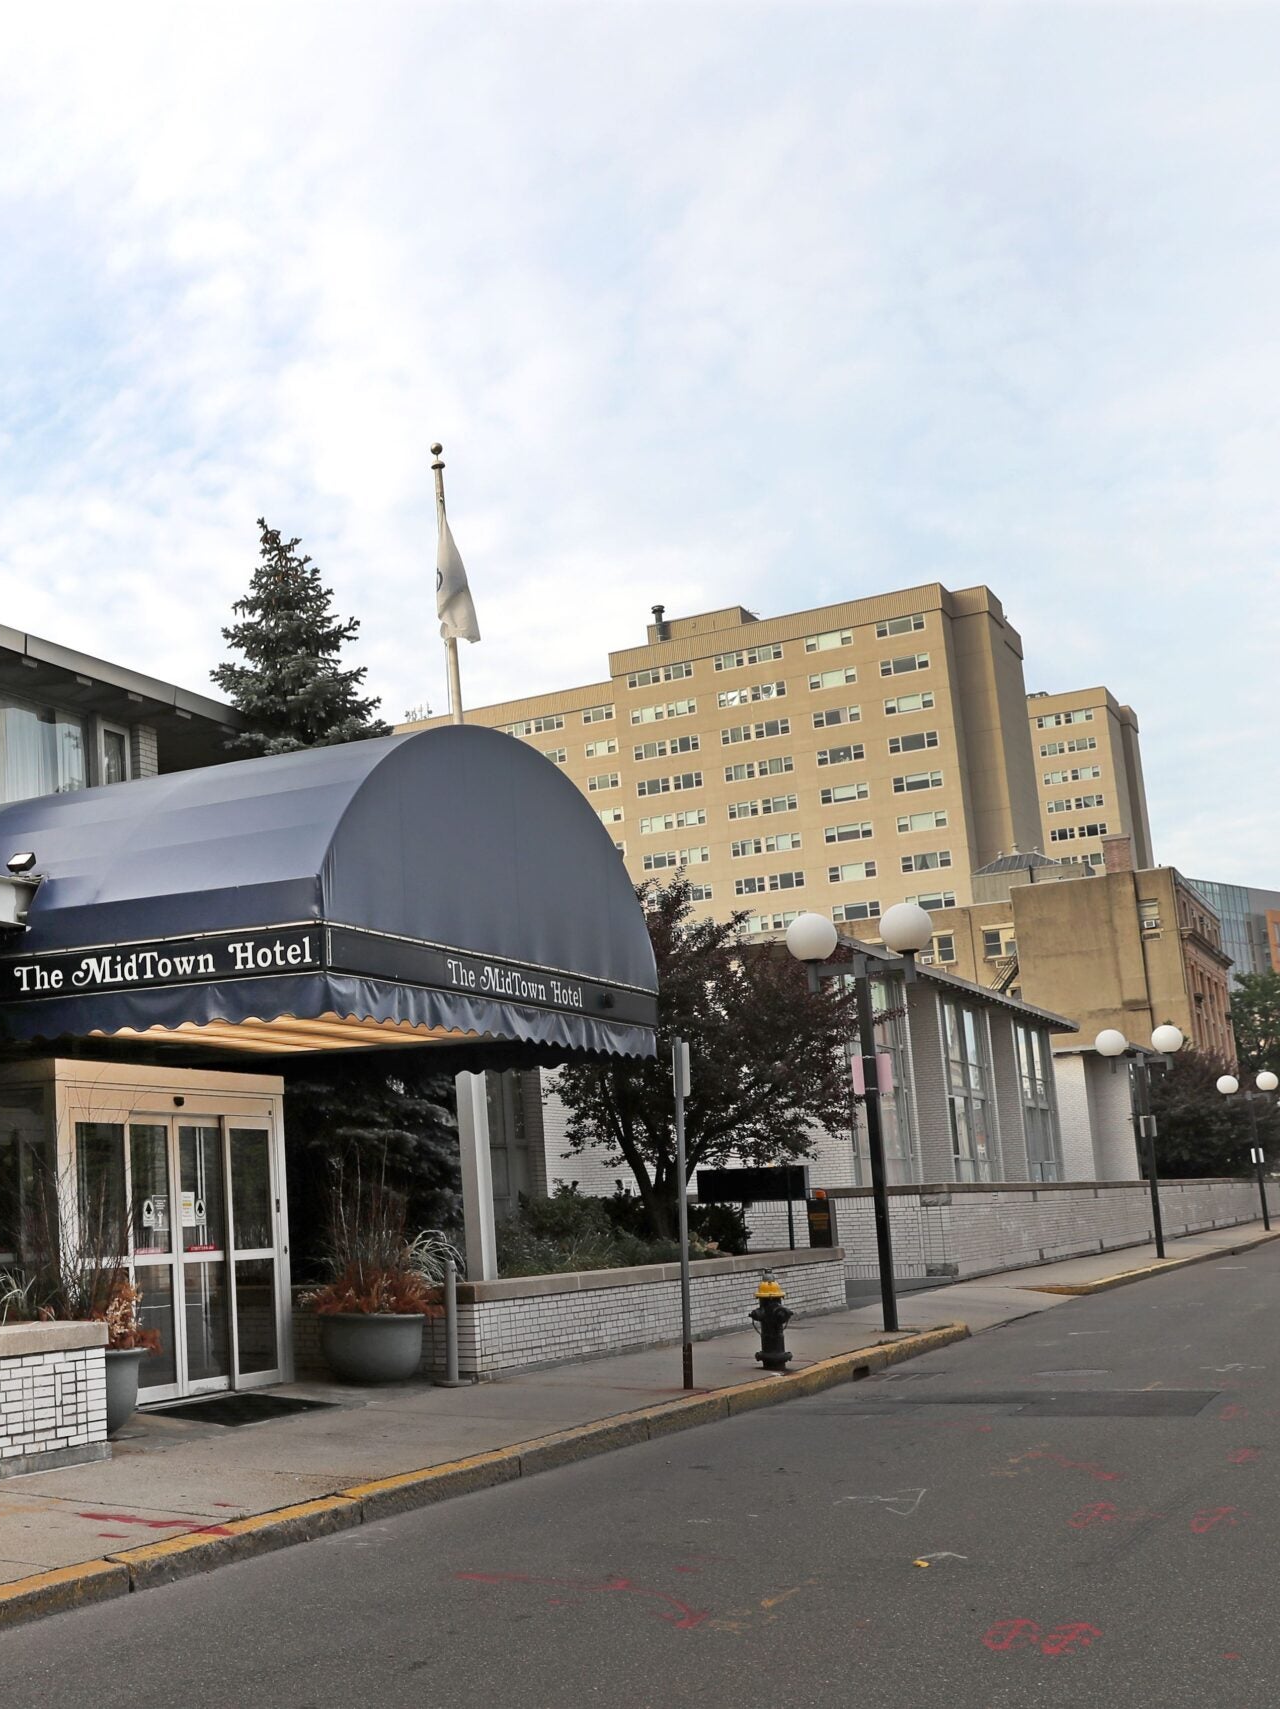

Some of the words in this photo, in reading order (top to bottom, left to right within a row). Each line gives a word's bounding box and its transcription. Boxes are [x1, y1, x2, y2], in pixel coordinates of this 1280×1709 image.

[14, 965, 64, 992] The
[72, 951, 215, 987] MidTown
[228, 936, 313, 970] Hotel
[447, 959, 475, 987] The
[479, 966, 546, 1001] MidTown
[550, 981, 583, 1008] Hotel
